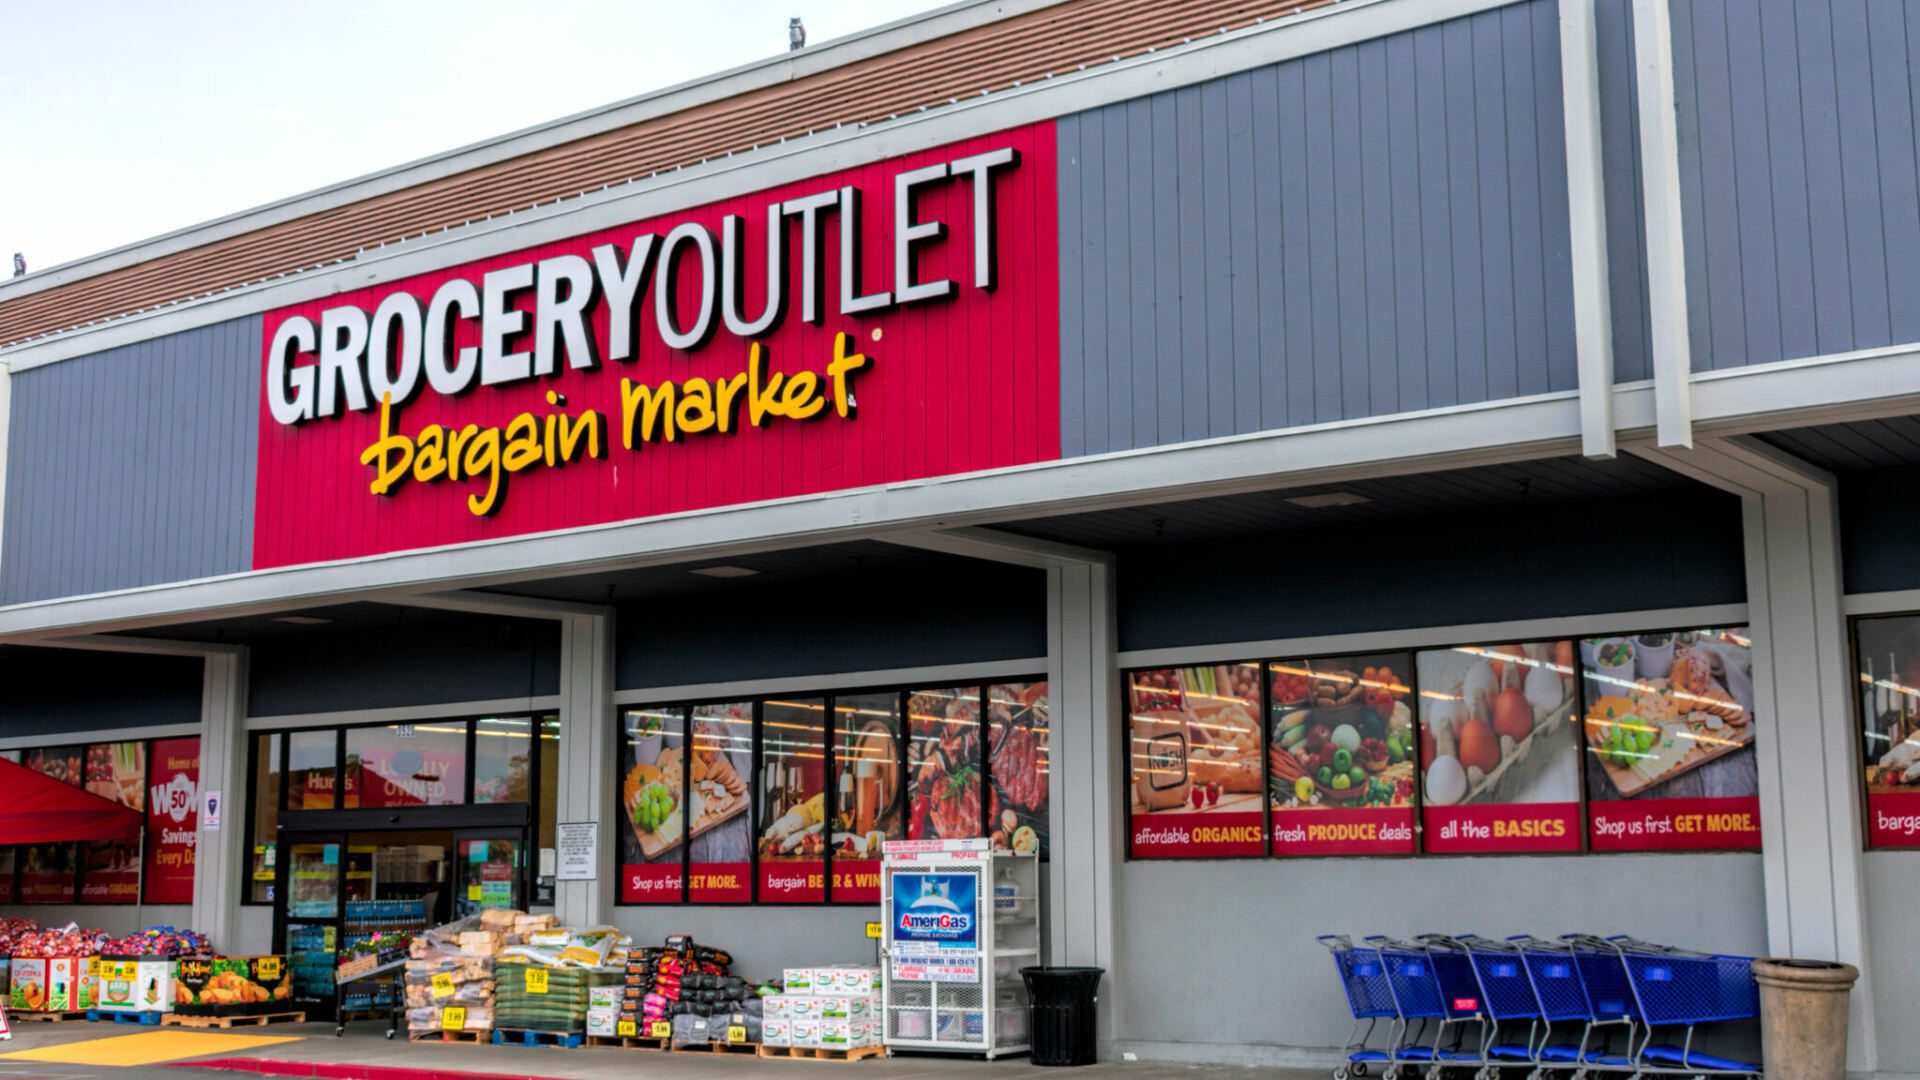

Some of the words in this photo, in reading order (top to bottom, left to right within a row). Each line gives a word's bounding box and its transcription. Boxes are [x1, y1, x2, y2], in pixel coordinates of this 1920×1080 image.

[360, 391, 602, 517] bargain
[621, 332, 867, 450] market
[384, 779, 446, 799] OWNED
[1440, 820, 1457, 838] all
[1461, 820, 1490, 838] the
[1493, 819, 1566, 838] BASICS
[1595, 815, 1626, 839] Shop
[1628, 821, 1643, 834] us
[1675, 815, 1704, 832] GET
[1878, 810, 1920, 835] barga
[1135, 826, 1190, 845] affordable
[1192, 826, 1262, 843] ORGANICS
[1274, 824, 1306, 842] fresh
[1308, 824, 1377, 841] PRODUCE
[1379, 823, 1412, 841] deals
[157, 848, 183, 868] Every
[632, 875, 653, 892] Shop
[654, 880, 664, 889] us
[768, 874, 806, 892] bargain
[808, 874, 842, 889] BER
[855, 873, 881, 888] WIN
[901, 914, 967, 928] AmeriGas
